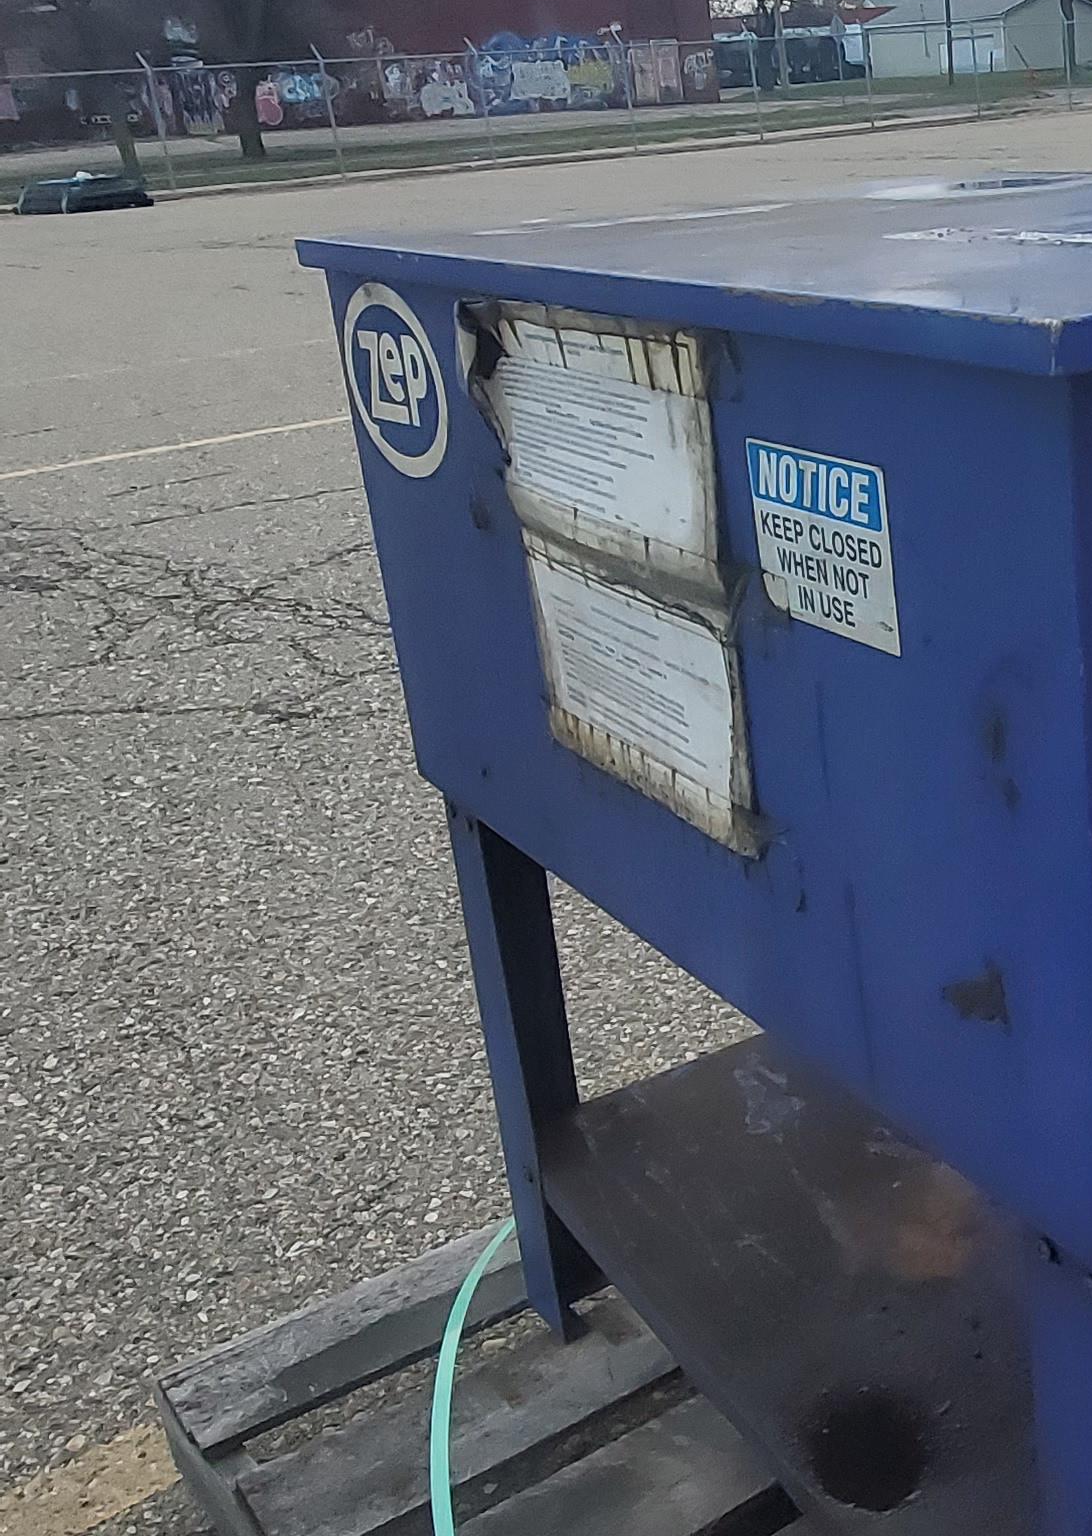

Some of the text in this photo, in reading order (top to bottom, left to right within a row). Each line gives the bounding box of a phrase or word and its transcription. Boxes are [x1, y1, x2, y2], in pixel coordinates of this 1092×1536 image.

[759, 449, 870, 524] NOTICE
[760, 509, 882, 569] KEEP CLOSED
[777, 546, 870, 599] WHEN NOT
[797, 584, 856, 628] IN USE
